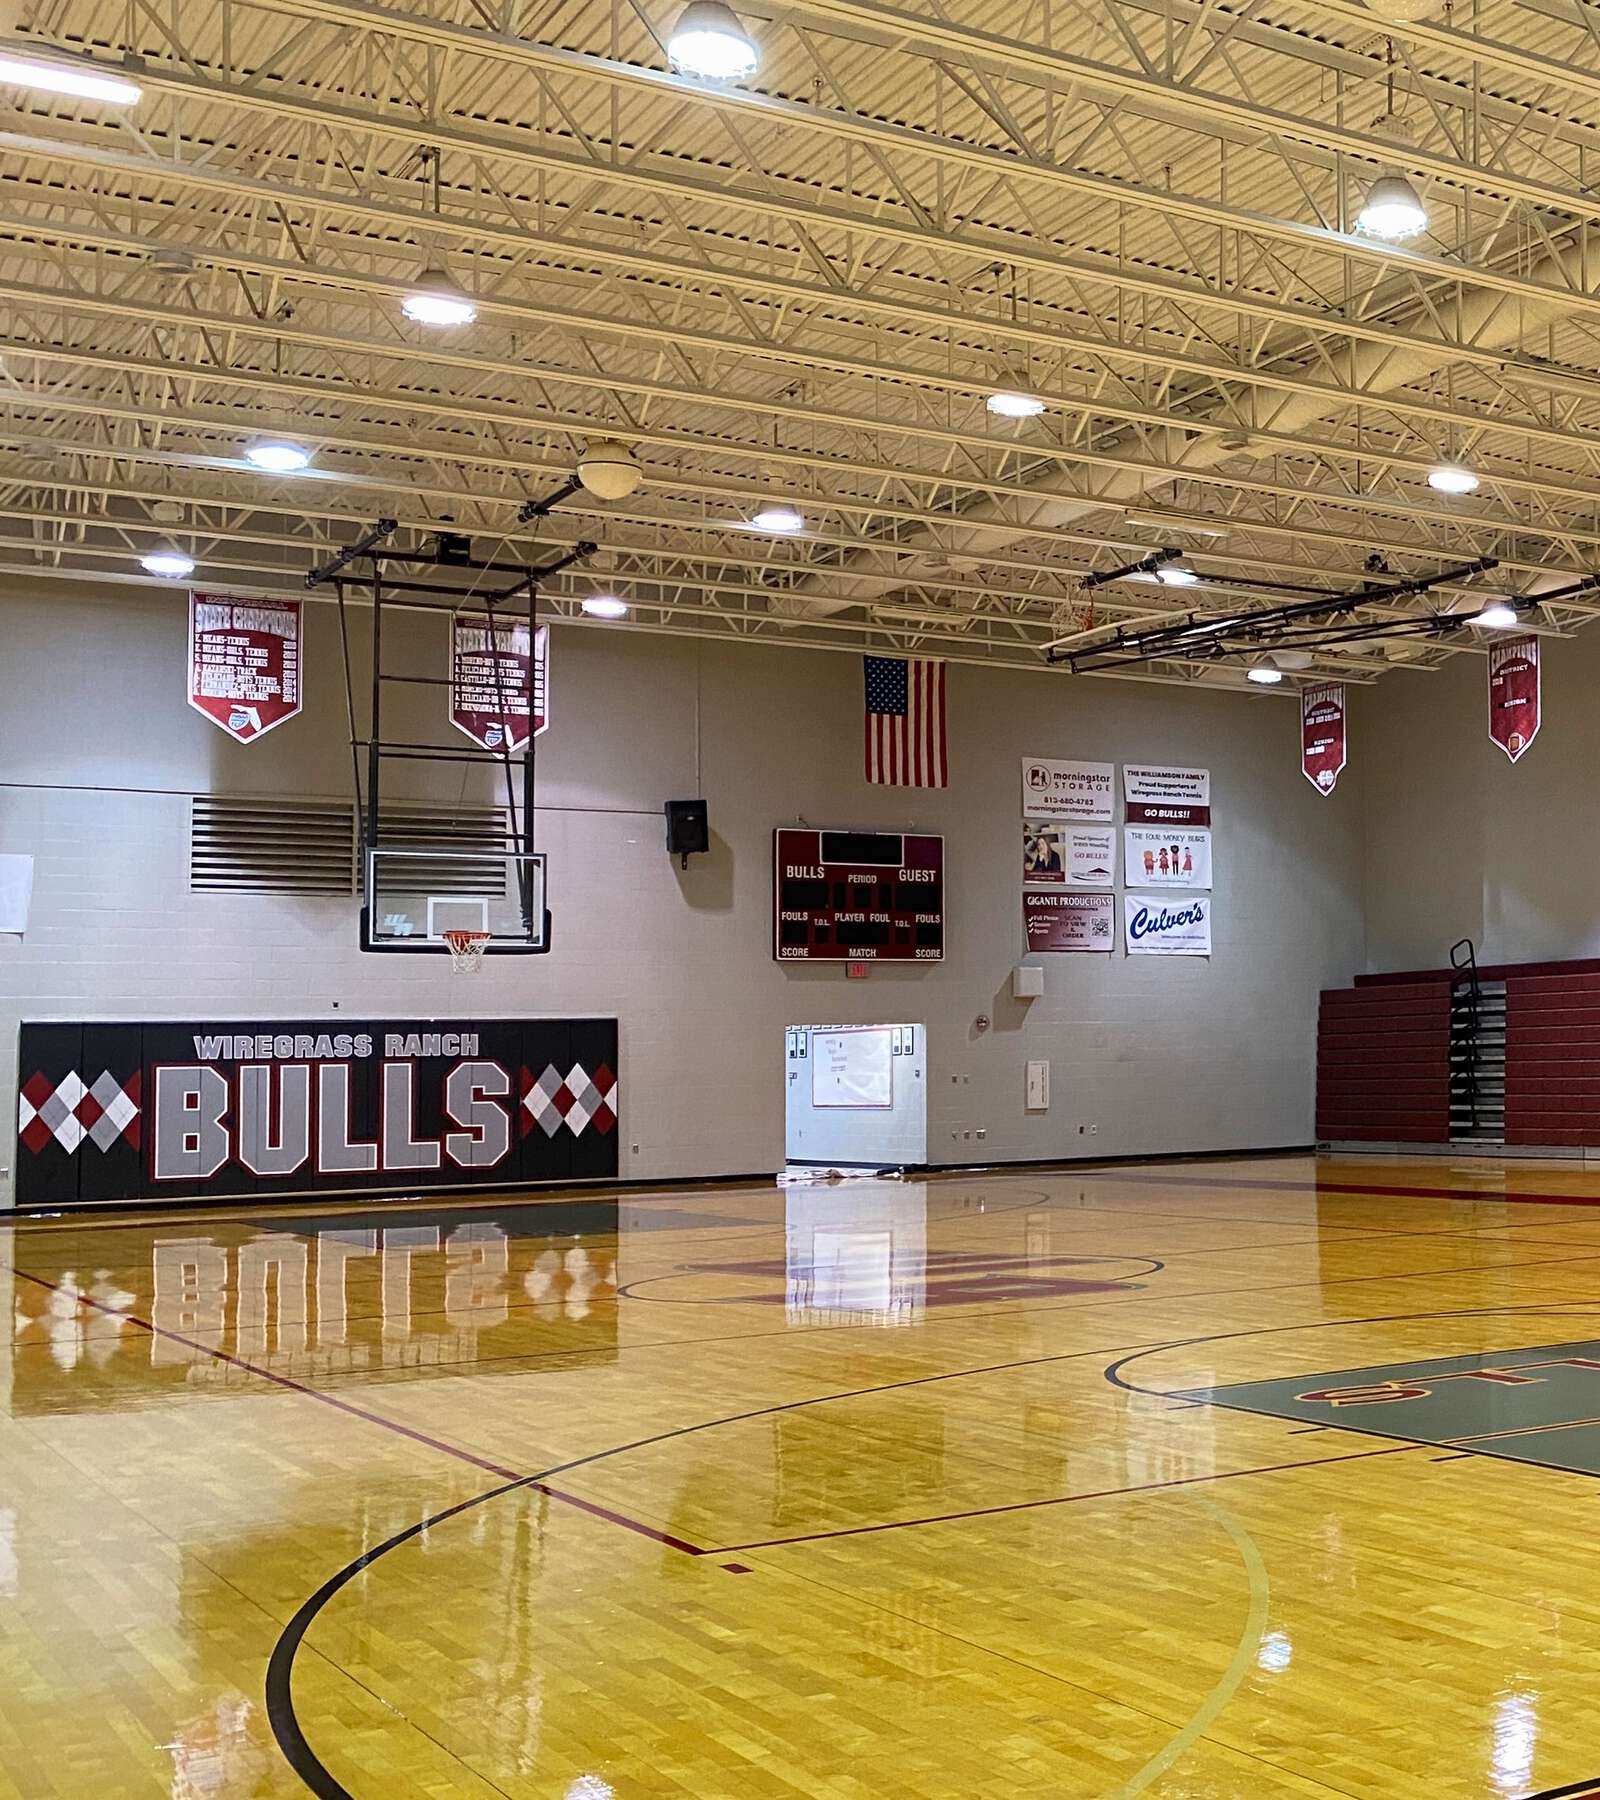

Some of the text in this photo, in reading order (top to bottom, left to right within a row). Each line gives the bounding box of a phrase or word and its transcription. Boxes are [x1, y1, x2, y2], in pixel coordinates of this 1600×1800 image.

[195, 603, 232, 632] STATE
[1500, 664, 1528, 675] DISTRICT
[1054, 772, 1110, 784] morningstar
[1141, 771, 1181, 779] WILLIAMSON
[1055, 782, 1110, 791] STORAGE
[1157, 782, 1190, 790] Supporters
[1131, 789, 1162, 797] Wiregrass
[1027, 805, 1110, 815] morningstarstorage.com
[1144, 809, 1190, 818] GO BULLS!!
[1131, 832, 1143, 840] THE
[1145, 833, 1161, 841] FOUR
[1163, 834, 1185, 842] MONEY
[786, 865, 825, 879] BULLS
[899, 869, 936, 882] GUEST
[848, 875, 877, 884] PERIOD
[1027, 896, 1111, 906] GIGANTE PRODUCTIONS
[781, 912, 808, 921] FOULS
[834, 913, 890, 922] PLAYER FOUL
[916, 914, 941, 924] FOULS
[1130, 902, 1204, 940] Culver's
[781, 948, 808, 957] SCORE
[849, 948, 876, 957] MATCH
[916, 949, 941, 958] SCORE
[193, 1033, 479, 1060] WIREGRASS RANCH
[151, 1060, 512, 1182] BULLS
